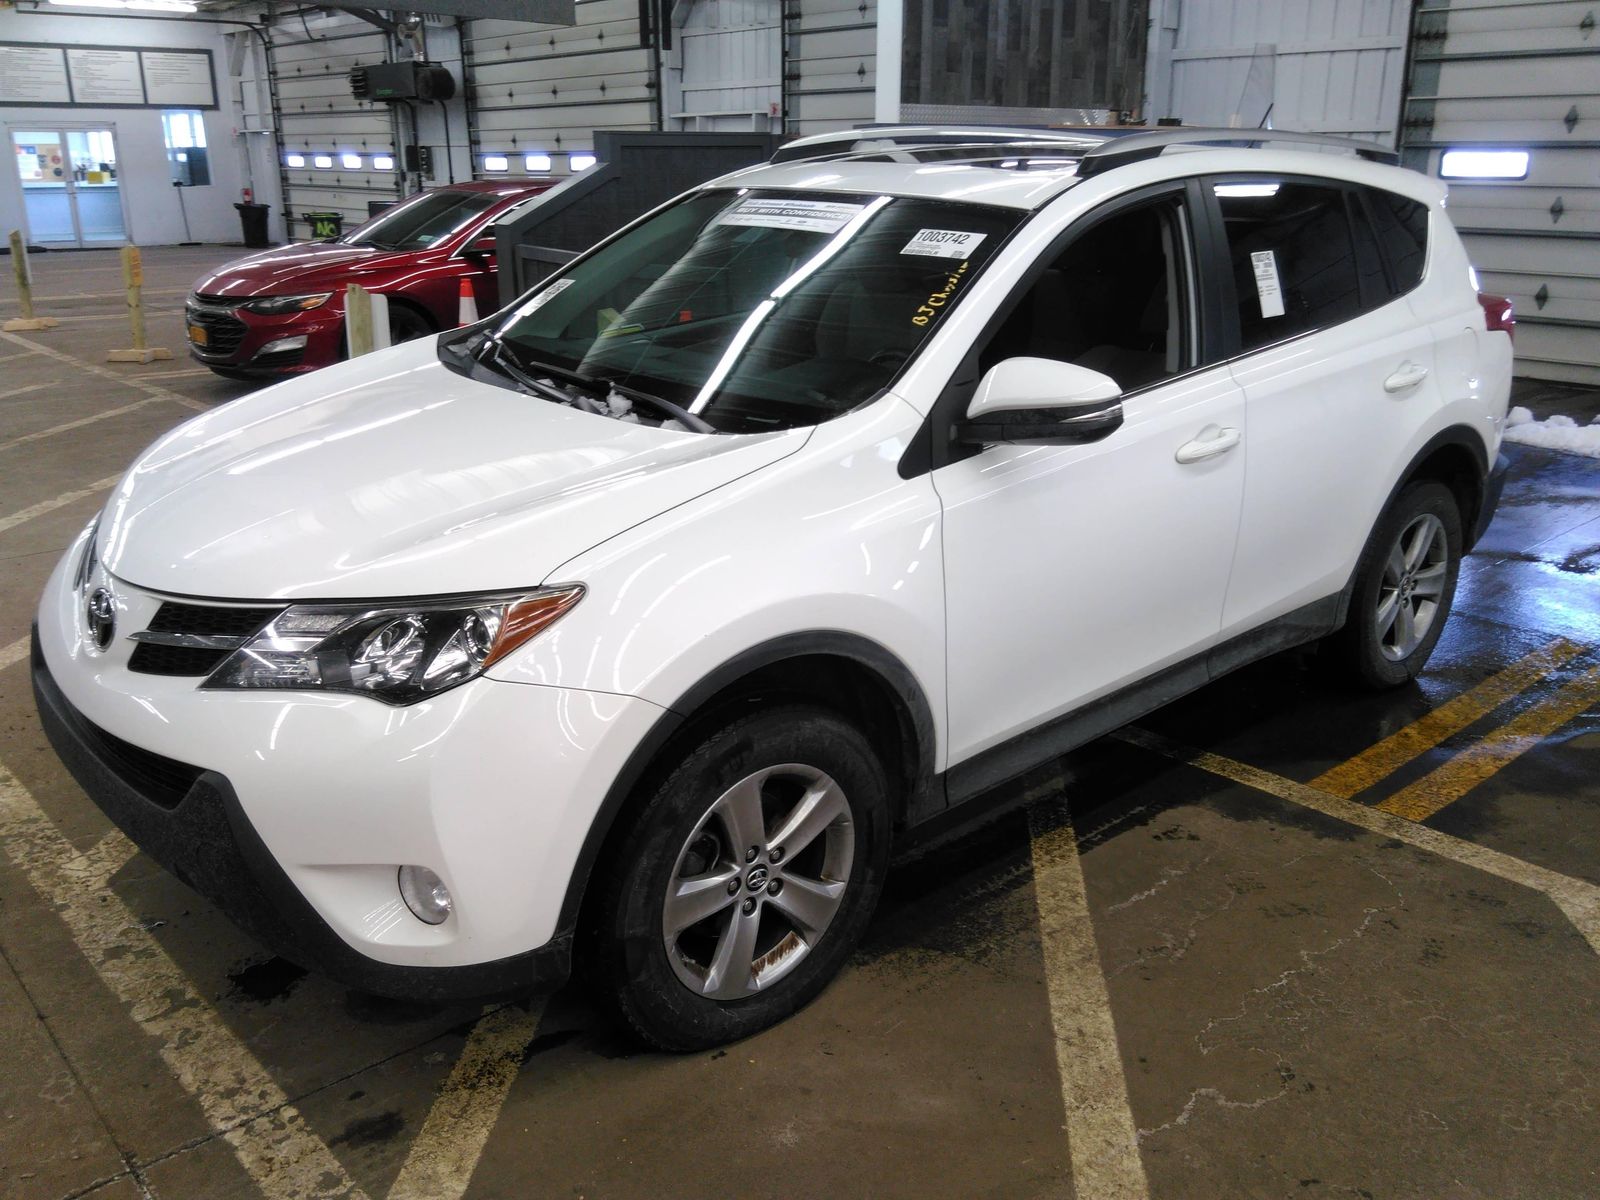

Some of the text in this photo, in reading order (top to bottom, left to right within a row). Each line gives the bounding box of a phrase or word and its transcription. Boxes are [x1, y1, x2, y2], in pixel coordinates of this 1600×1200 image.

[736, 206, 758, 214] BUY
[782, 208, 846, 220] CONFIDENCE
[918, 231, 970, 245] 1003742
